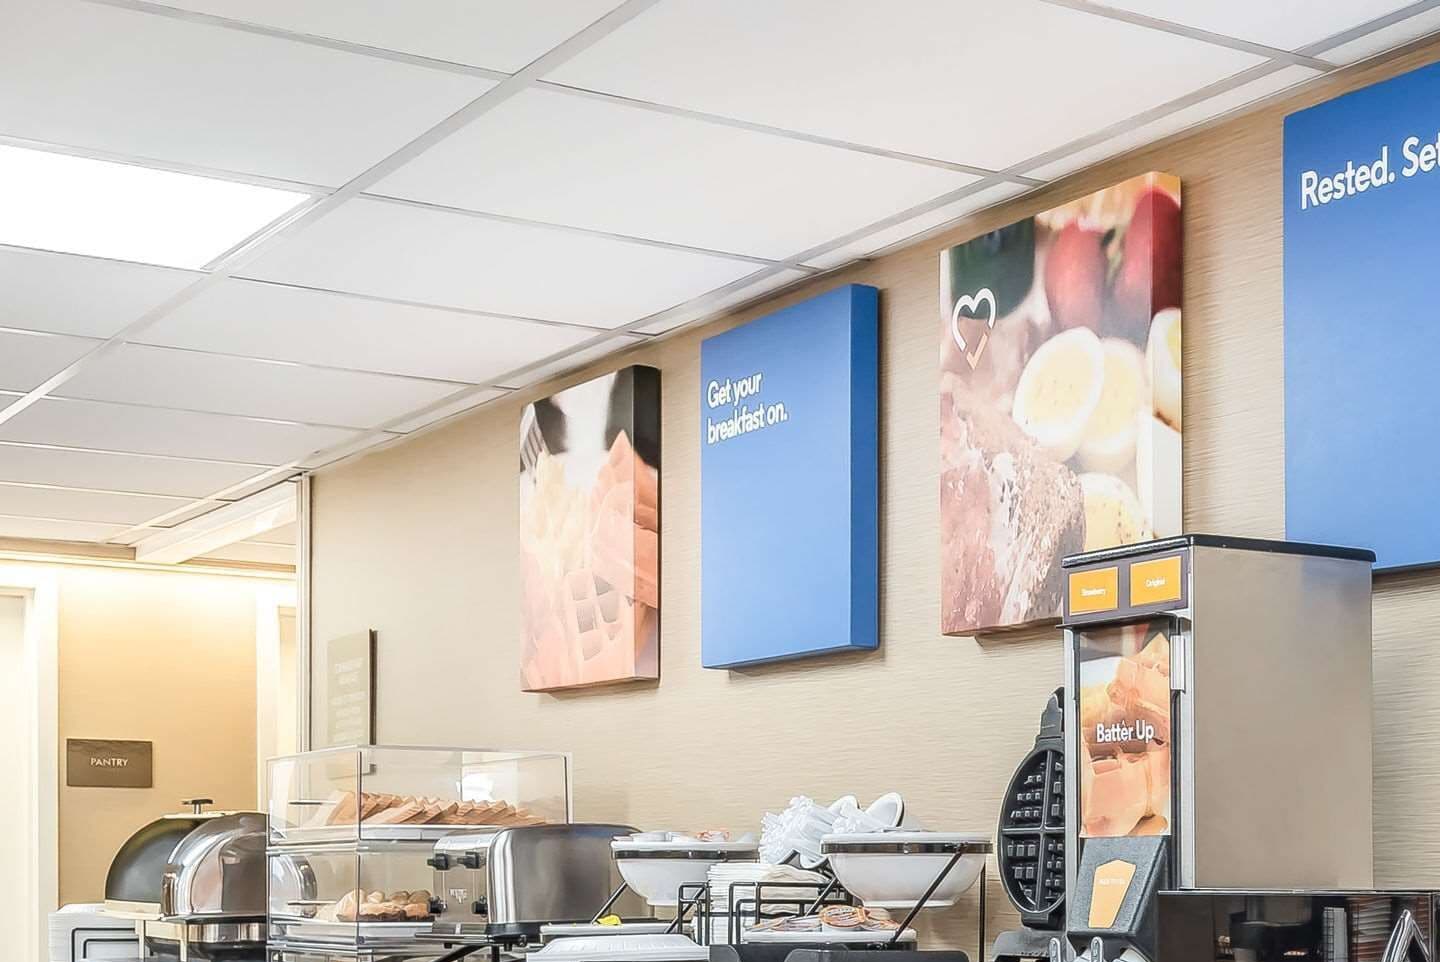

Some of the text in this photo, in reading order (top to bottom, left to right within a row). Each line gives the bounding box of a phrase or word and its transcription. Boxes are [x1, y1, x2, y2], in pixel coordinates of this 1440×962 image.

[1300, 145, 1396, 210] Rested.
[707, 373, 762, 409] Get your
[707, 402, 788, 444] breakfast on.
[1096, 719, 1154, 744] Batter Up
[90, 757, 128, 767] PANTRY
